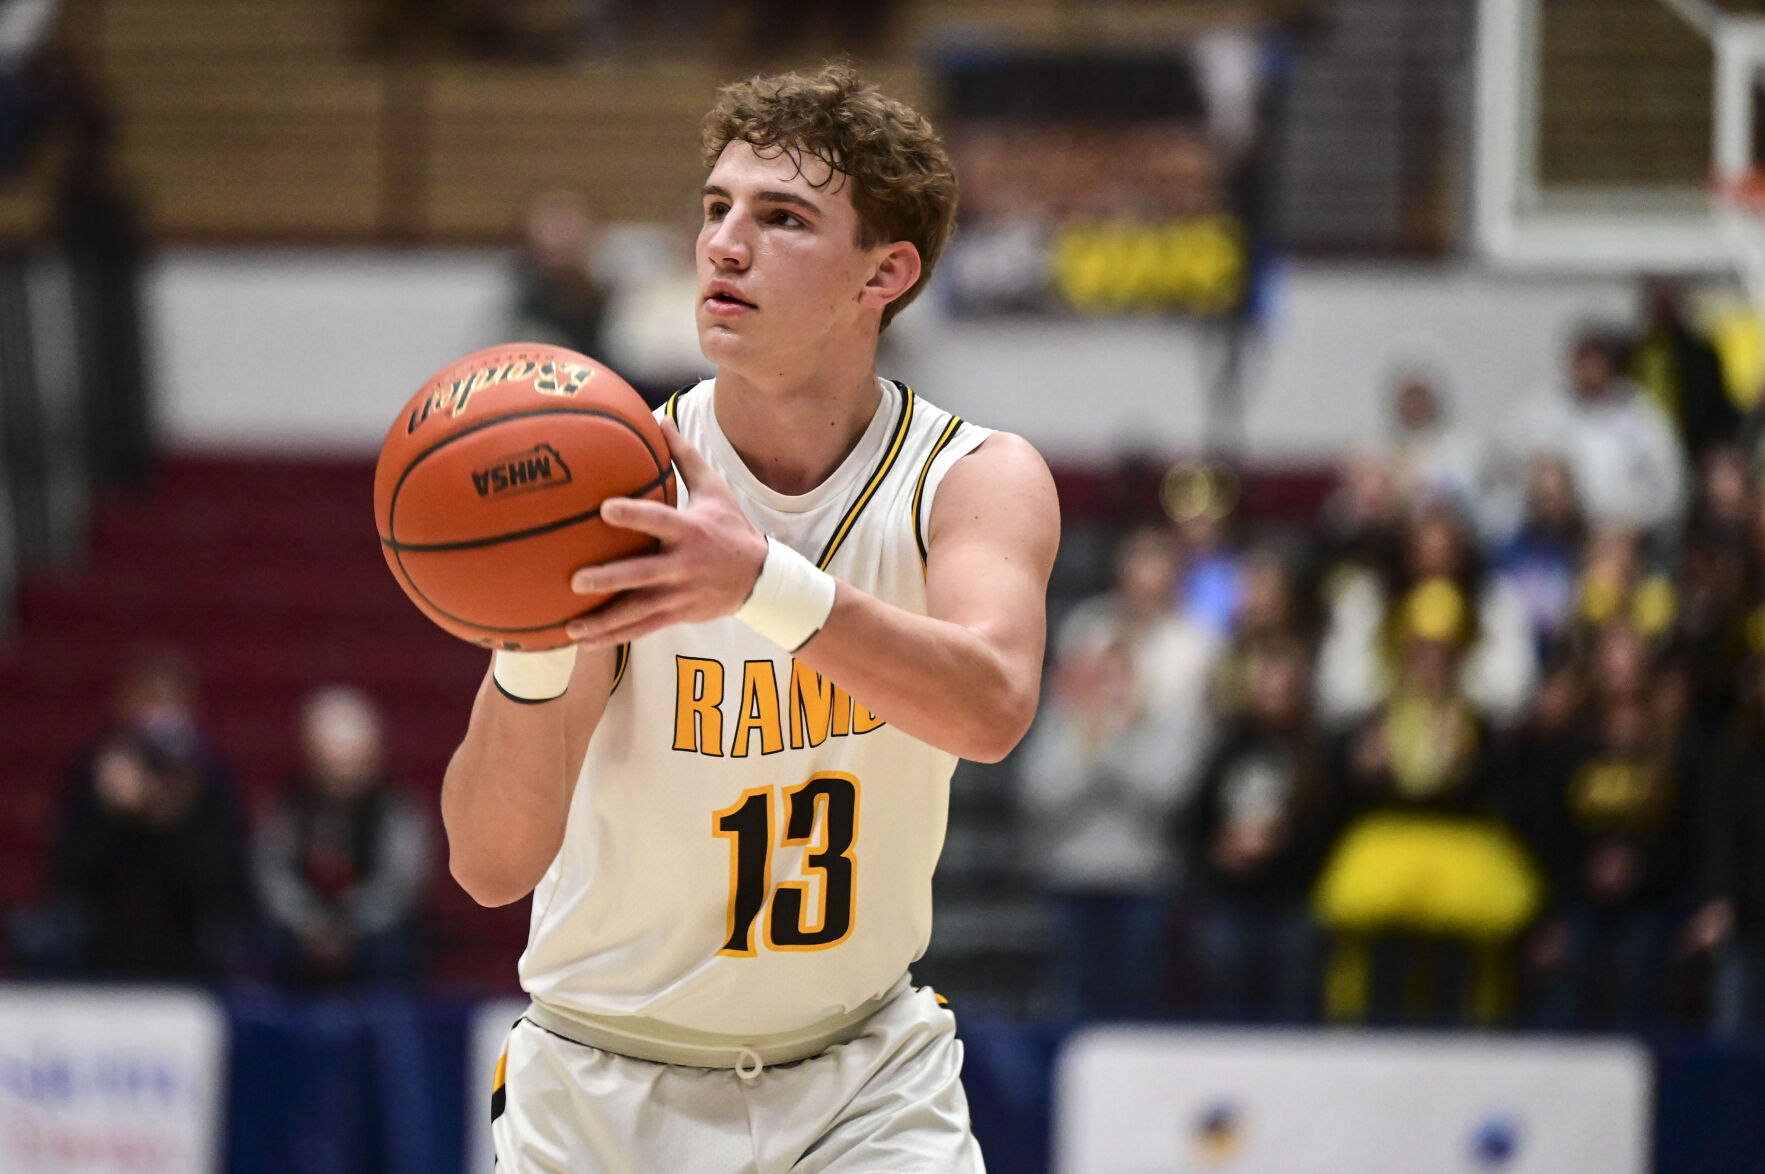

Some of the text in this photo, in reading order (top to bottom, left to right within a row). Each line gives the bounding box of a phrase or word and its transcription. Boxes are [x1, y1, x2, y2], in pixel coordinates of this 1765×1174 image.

[408, 361, 594, 434] Baden
[471, 456, 551, 496] MHSA
[711, 770, 861, 957] 13
